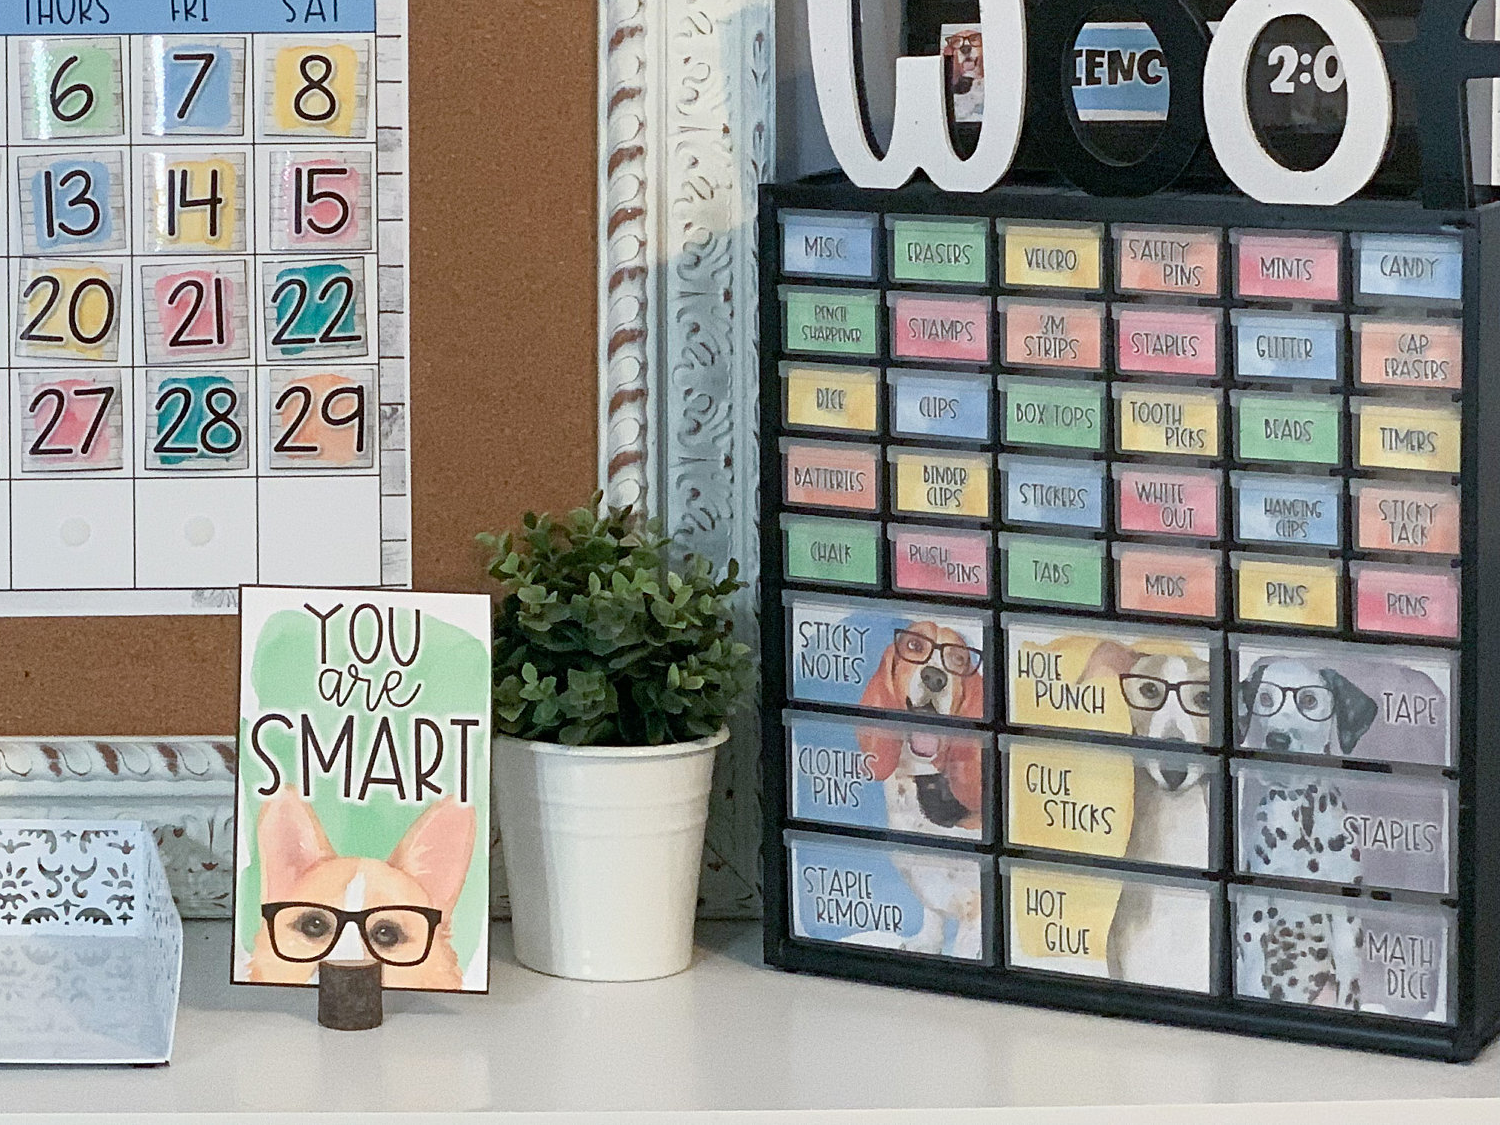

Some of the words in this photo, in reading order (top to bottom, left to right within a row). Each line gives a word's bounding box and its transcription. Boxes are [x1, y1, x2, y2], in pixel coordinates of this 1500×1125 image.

[50, 55, 94, 122] 6
[173, 53, 214, 119] 7
[293, 54, 337, 121] 8
[44, 169, 101, 238] 13
[168, 169, 222, 236] 14
[294, 167, 349, 235] 15
[907, 242, 974, 266] ERASERS
[1024, 248, 1077, 271] VELCRO
[1128, 239, 1191, 262] SAFETY
[1162, 263, 1204, 288] PINS
[1260, 256, 1315, 282] MINTS
[1380, 254, 1440, 280] CANDY
[20, 275, 114, 345] 20
[167, 277, 224, 347] 21
[271, 275, 361, 345] 22
[908, 317, 976, 342] STAMPS
[1023, 336, 1081, 360] STRIPS
[1130, 332, 1201, 358] STAPLES
[1256, 335, 1313, 361] GLITTER
[1398, 333, 1431, 355] CAP
[1383, 356, 1451, 381] ERASERS
[816, 387, 845, 412] DICE
[918, 396, 960, 420] CLIPS
[28, 386, 115, 456] 27
[153, 386, 242, 454] 28
[274, 385, 364, 453] 29
[1016, 402, 1046, 426] BOX
[1054, 404, 1096, 430] TOPS
[1130, 402, 1183, 426] TOOTH
[1164, 427, 1208, 450] PICKS
[1264, 418, 1315, 443] BEADS
[1380, 427, 1439, 454] TIMERS
[794, 468, 867, 492] BATTERIES
[923, 465, 968, 486] BINDER
[926, 488, 964, 508] CLIPS
[1018, 483, 1090, 510] STICKERS
[1134, 481, 1185, 505] WHITE
[1161, 506, 1195, 530] OUT
[1379, 500, 1439, 522] STICKY
[1275, 518, 1310, 539] CLIPS
[1389, 520, 1430, 545] TACK
[810, 541, 853, 565] CHALK
[909, 544, 949, 566] PUSH
[947, 562, 980, 584] PINS
[1032, 560, 1073, 586] TABS
[1145, 574, 1186, 599] MEDS
[1265, 581, 1309, 607] PINS
[1386, 593, 1430, 618] PENS
[303, 602, 421, 667] YOU
[799, 621, 870, 654] STICKY
[801, 653, 865, 685] NOTES
[1018, 649, 1063, 682] HOLE
[318, 663, 422, 712] are
[1036, 681, 1105, 715] PUNCH
[1383, 692, 1438, 726] TAPE
[251, 713, 480, 803] SMART
[799, 747, 877, 781] CLOTHES
[1026, 763, 1072, 796] GLUE
[813, 779, 862, 808] PINS
[1044, 800, 1116, 835] STICKS
[1343, 816, 1438, 853] STAPLES
[803, 866, 873, 899] STAPLE
[816, 898, 904, 932] REMOVER
[1026, 888, 1067, 919] HOT
[1044, 923, 1090, 956] GLUE
[1369, 933, 1434, 966] MATH
[1387, 968, 1428, 1000] DICE
